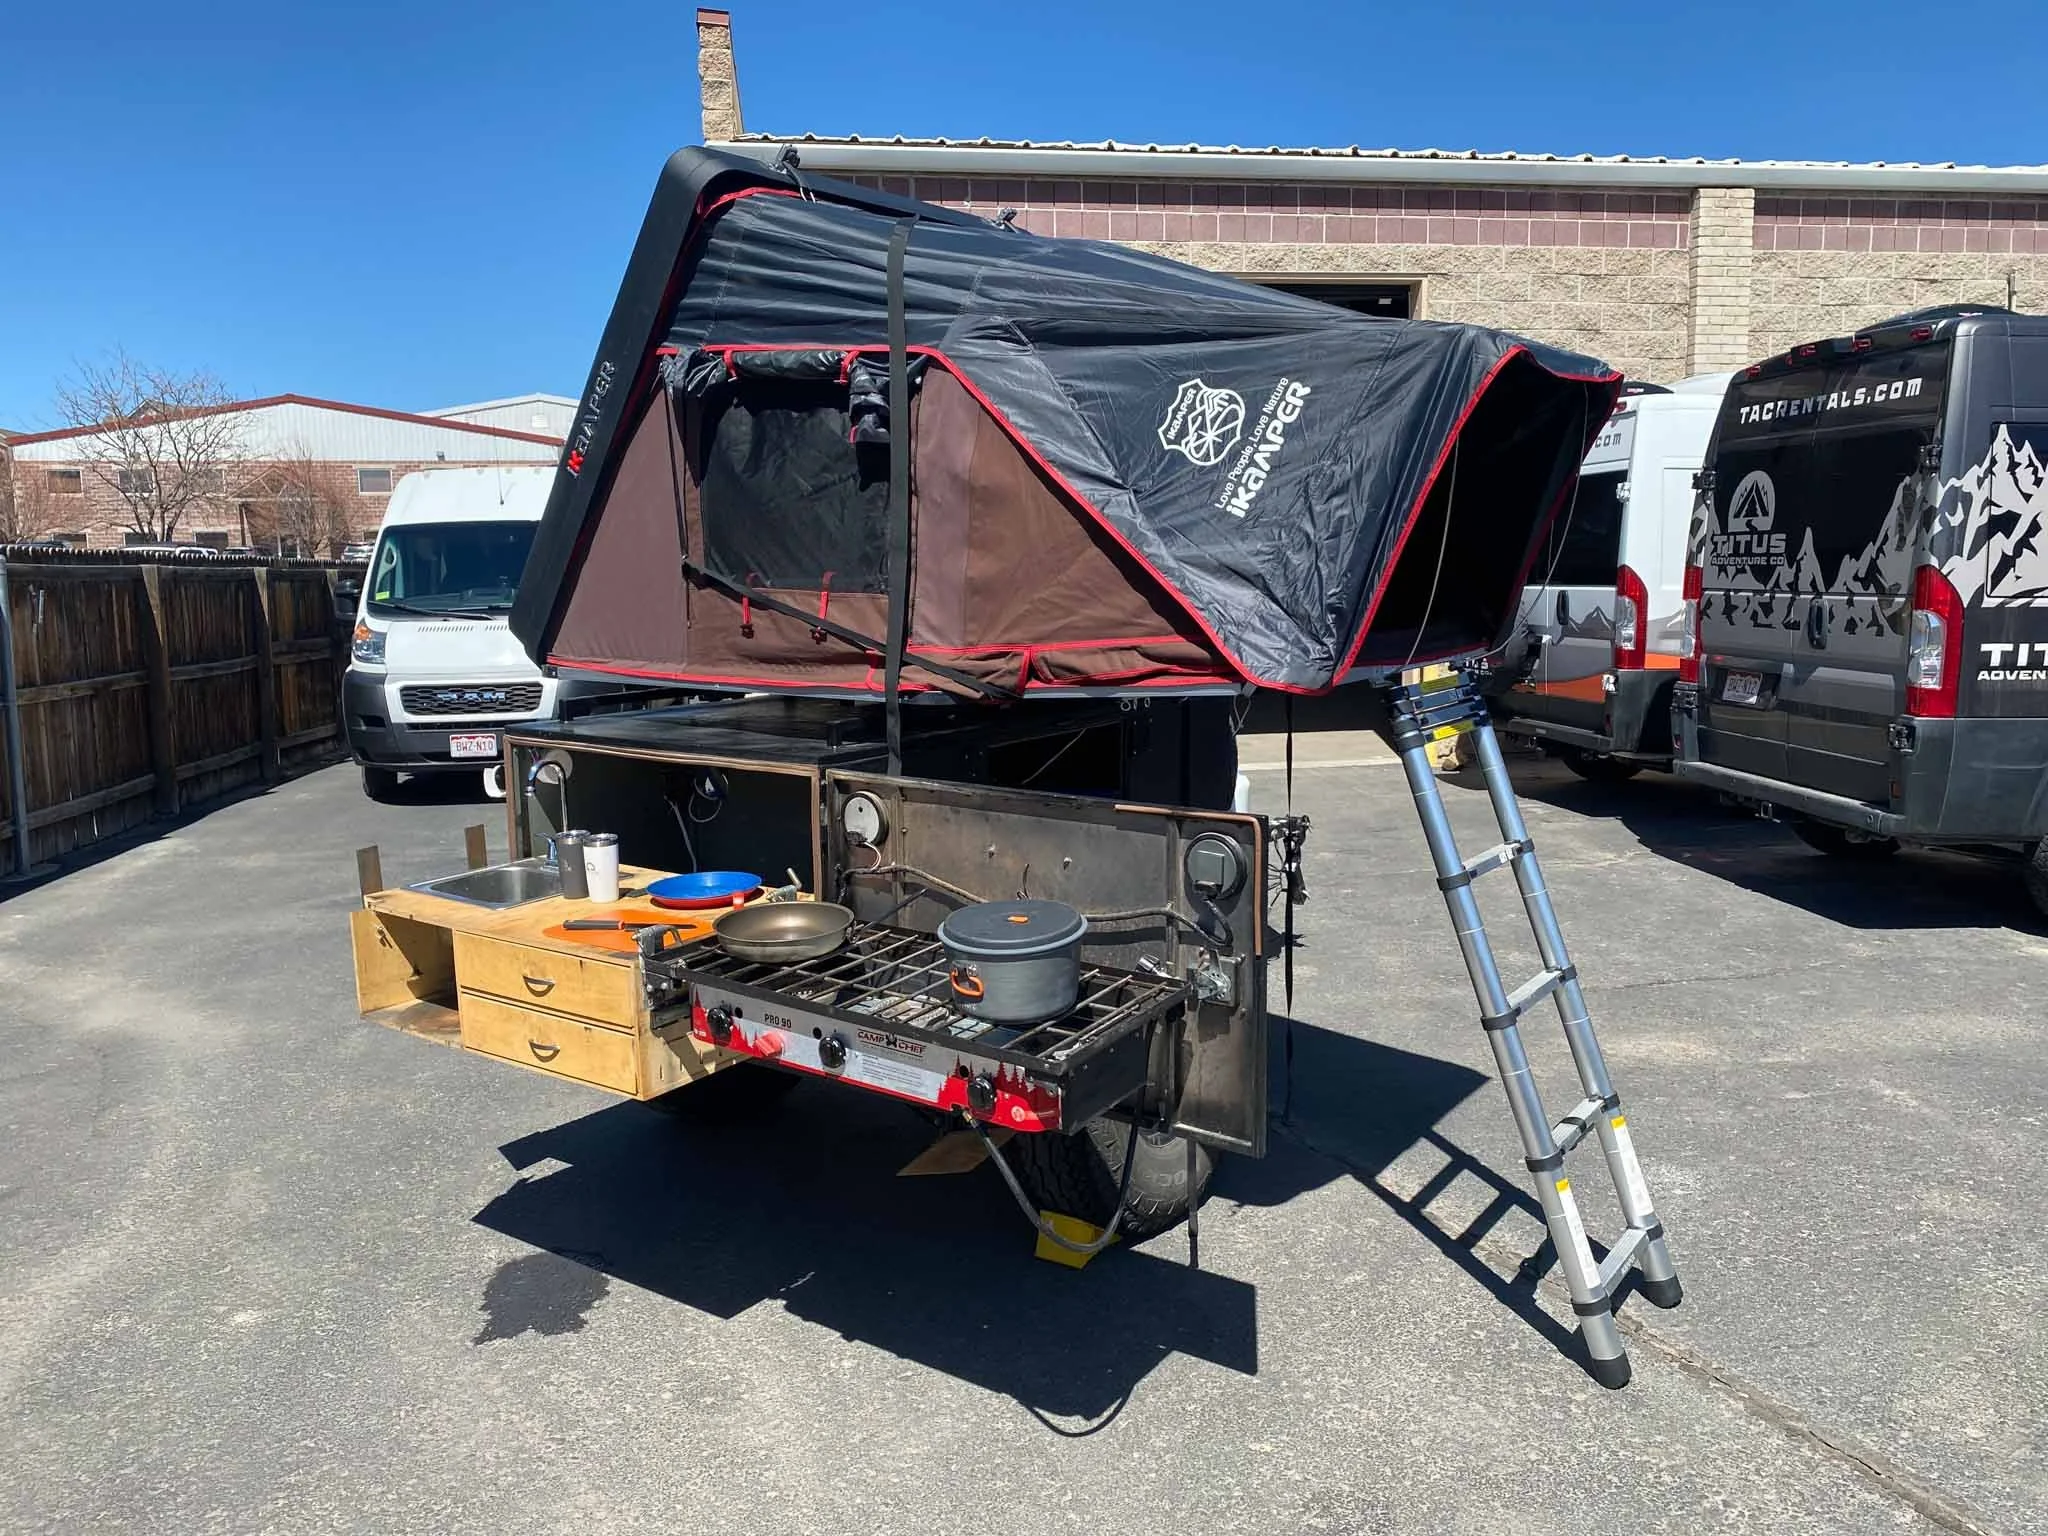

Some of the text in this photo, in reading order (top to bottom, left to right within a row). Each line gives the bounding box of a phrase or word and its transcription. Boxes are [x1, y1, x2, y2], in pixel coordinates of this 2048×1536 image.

[1740, 377, 1922, 425] TACRENTALS.COM
[1214, 482, 1235, 509] Love
[1248, 415, 1269, 442] Love
[1262, 377, 1289, 414] Nature
[1713, 533, 1787, 555] TITUS
[1711, 556, 1785, 566] ADVENTURE CO
[764, 1013, 792, 1029] PRO 90
[857, 1030, 884, 1044] CAMP
